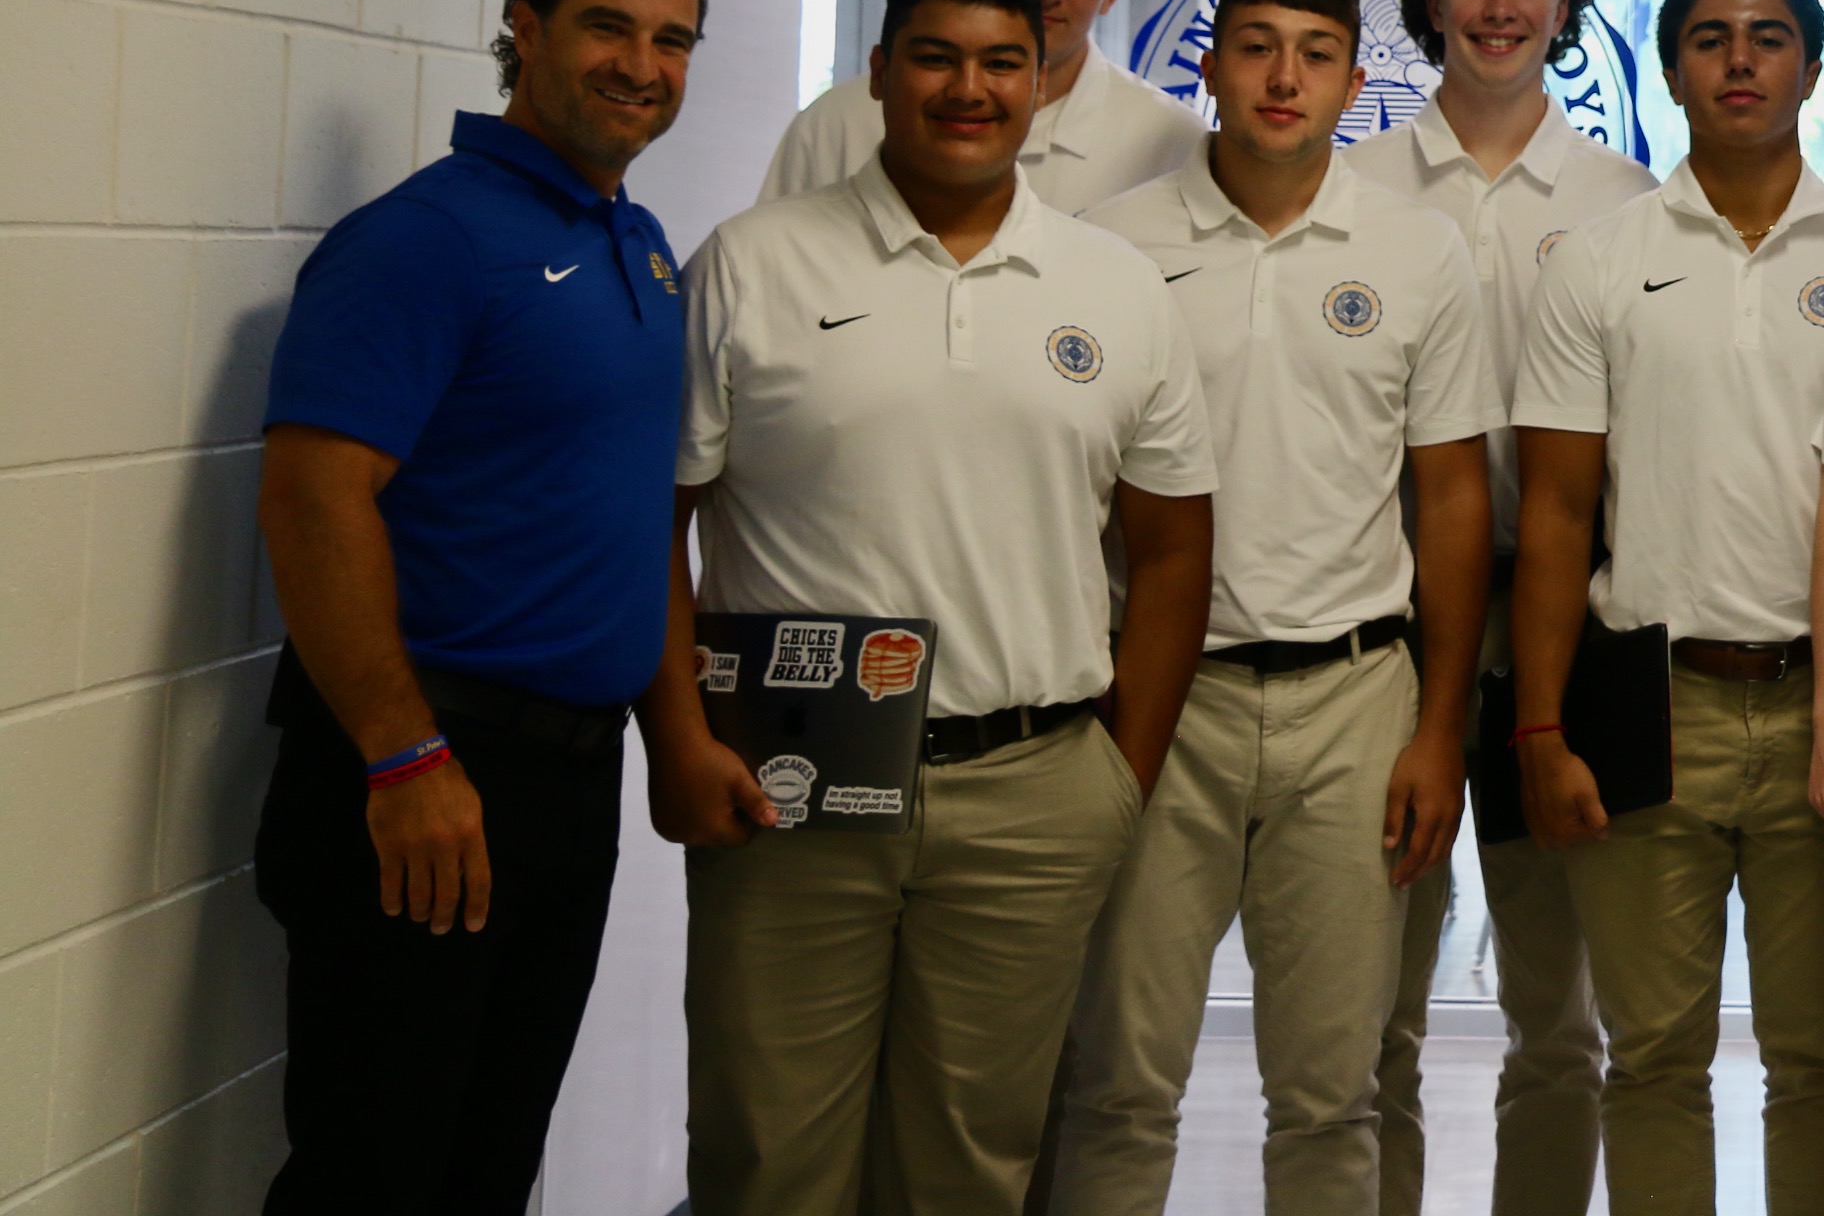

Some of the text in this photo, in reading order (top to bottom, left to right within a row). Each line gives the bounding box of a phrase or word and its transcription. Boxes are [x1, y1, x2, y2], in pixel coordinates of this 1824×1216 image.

[780, 627, 838, 646] CHICKS
[777, 646, 836, 664] DIG THE
[716, 656, 736, 671] SAW
[770, 664, 838, 682] BELLY
[709, 674, 735, 689] THAT!
[762, 757, 815, 782] PANCAKES
[840, 789, 871, 801] straight
[872, 793, 883, 801] up
[825, 800, 852, 811] having
[859, 801, 882, 811] good
[882, 802, 900, 810] time
